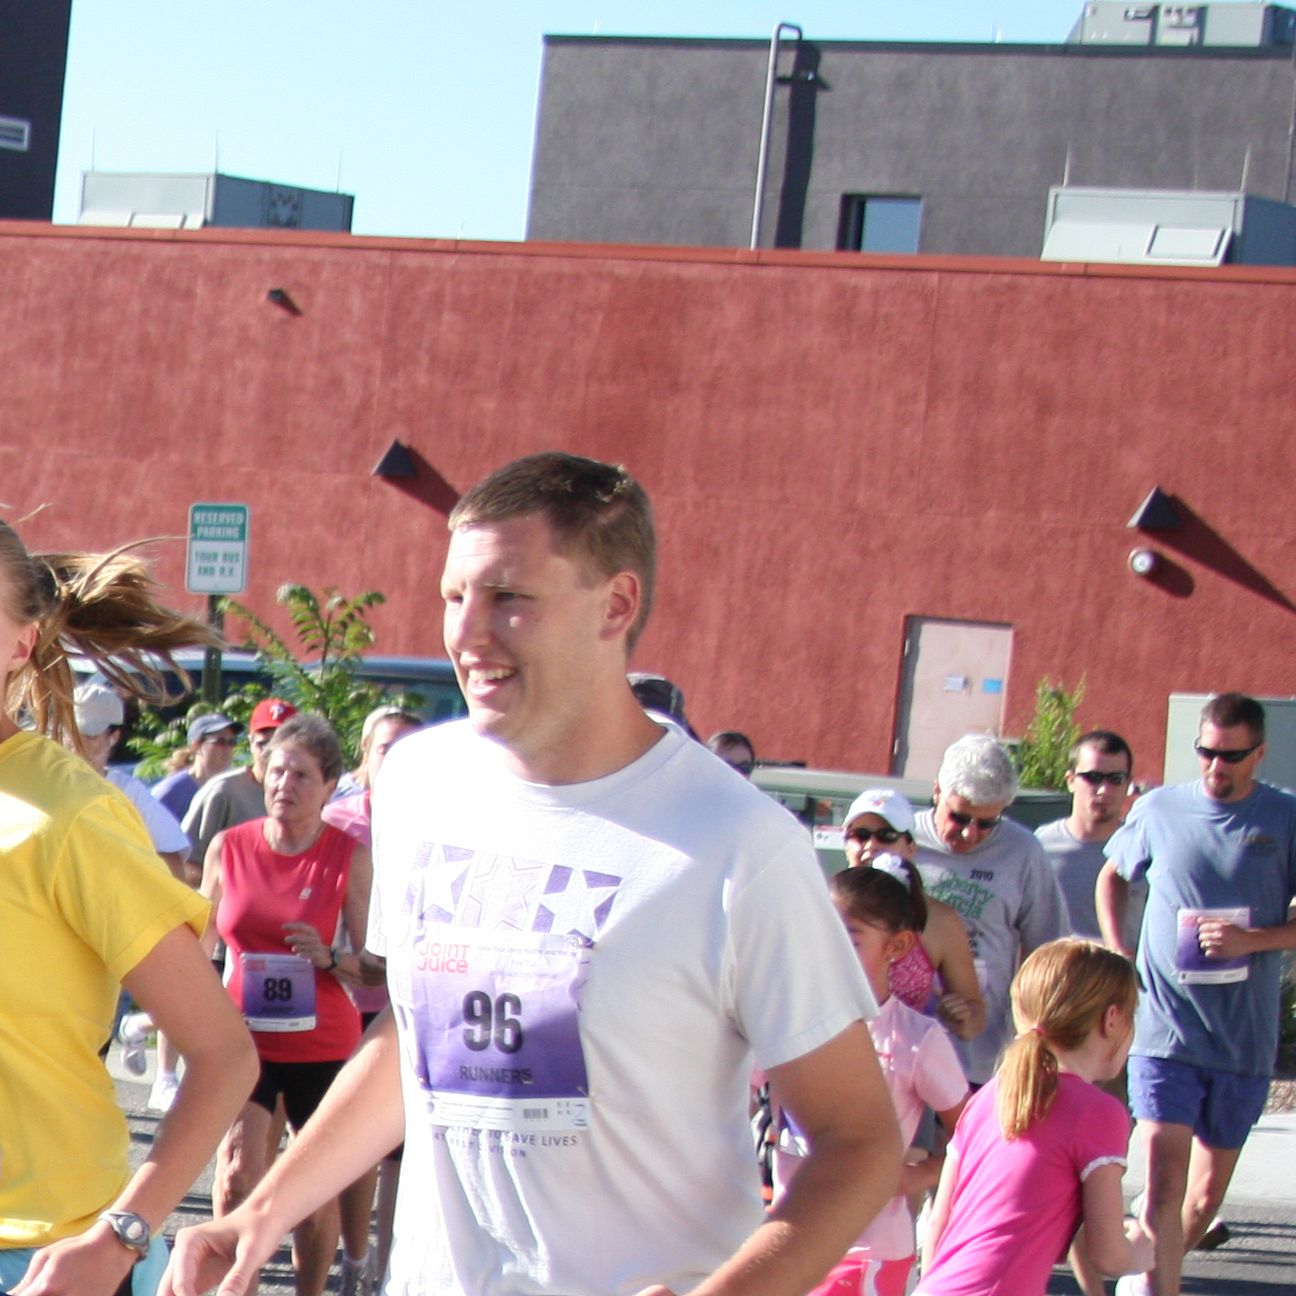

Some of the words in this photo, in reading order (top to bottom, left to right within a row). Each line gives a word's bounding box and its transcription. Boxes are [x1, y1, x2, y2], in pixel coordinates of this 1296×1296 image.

[193, 512, 244, 525] RESERVED
[196, 526, 240, 539] PARKING
[463, 990, 523, 1054] 96
[460, 1065, 533, 1084] RUNNERS
[541, 1135, 578, 1147] LIVES
